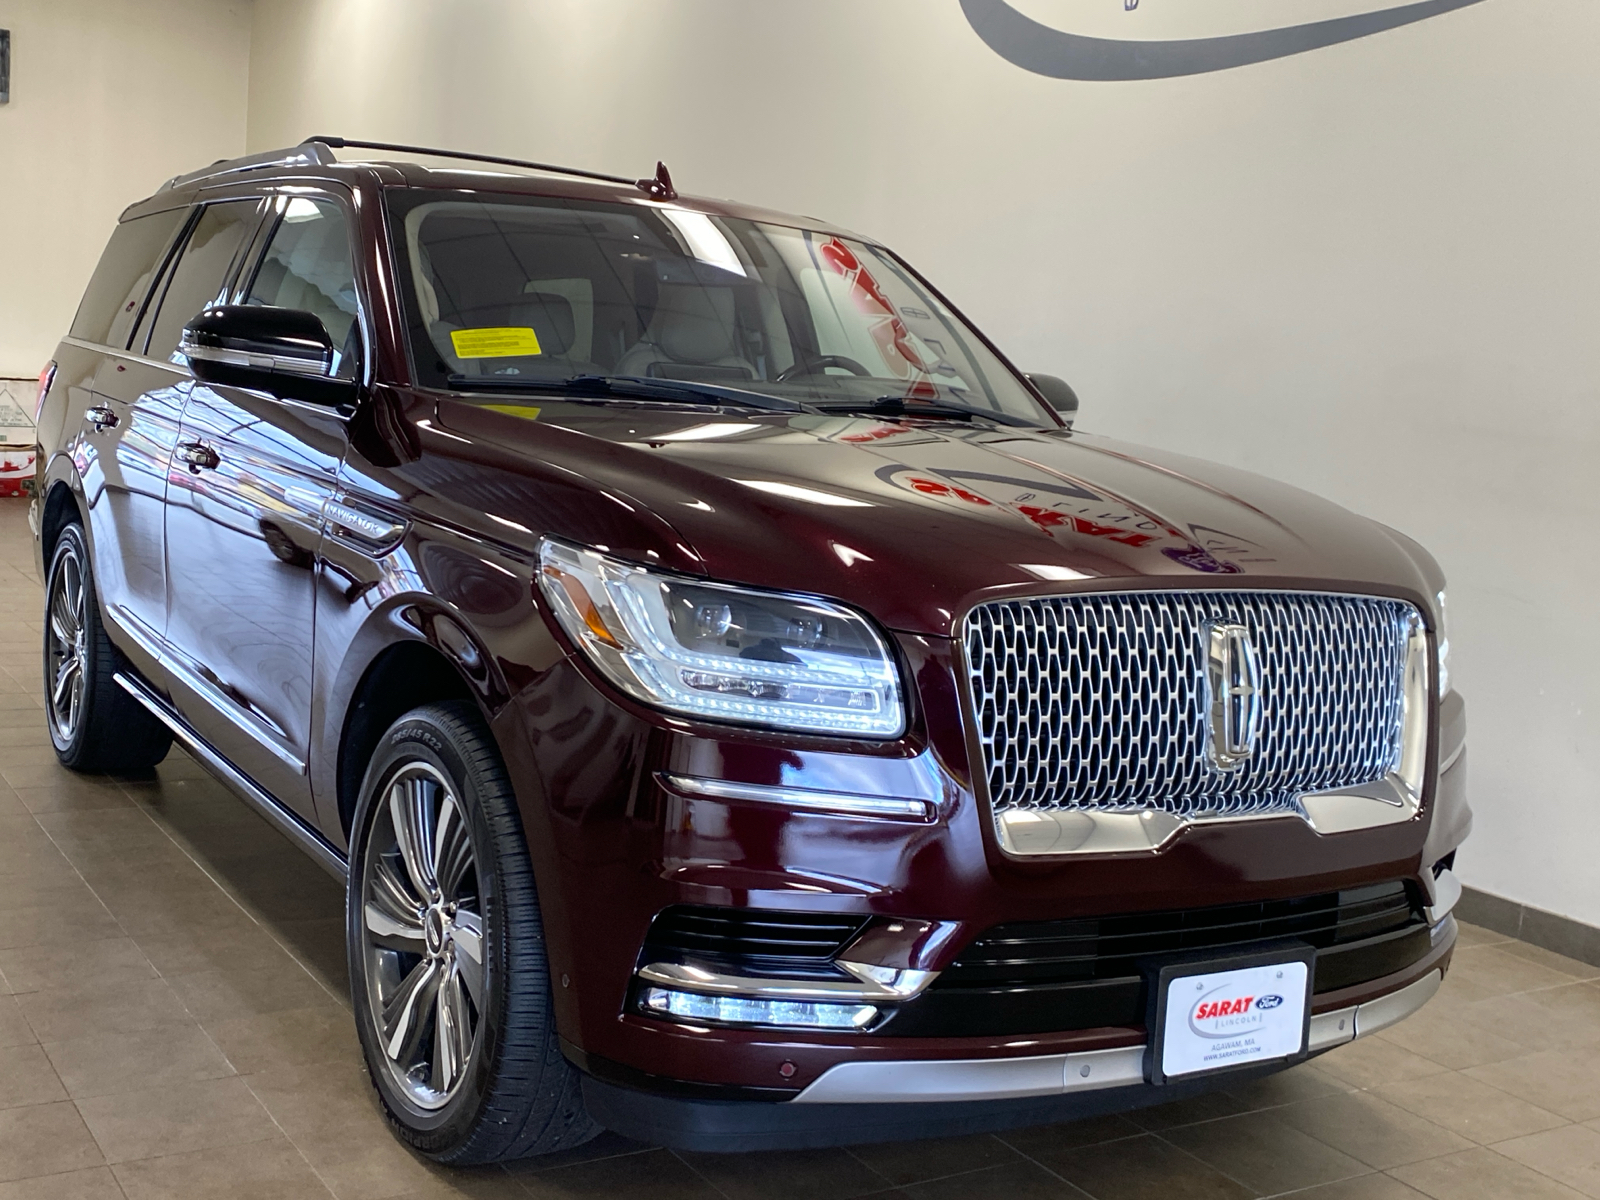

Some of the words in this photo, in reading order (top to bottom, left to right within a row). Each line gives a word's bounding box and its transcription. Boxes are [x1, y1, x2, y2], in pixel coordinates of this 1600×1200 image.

[1195, 995, 1255, 1020] SARAT
[1257, 995, 1282, 1009] Ford
[1221, 1016, 1257, 1028] LINCOLN
[1244, 1038, 1255, 1047] MA
